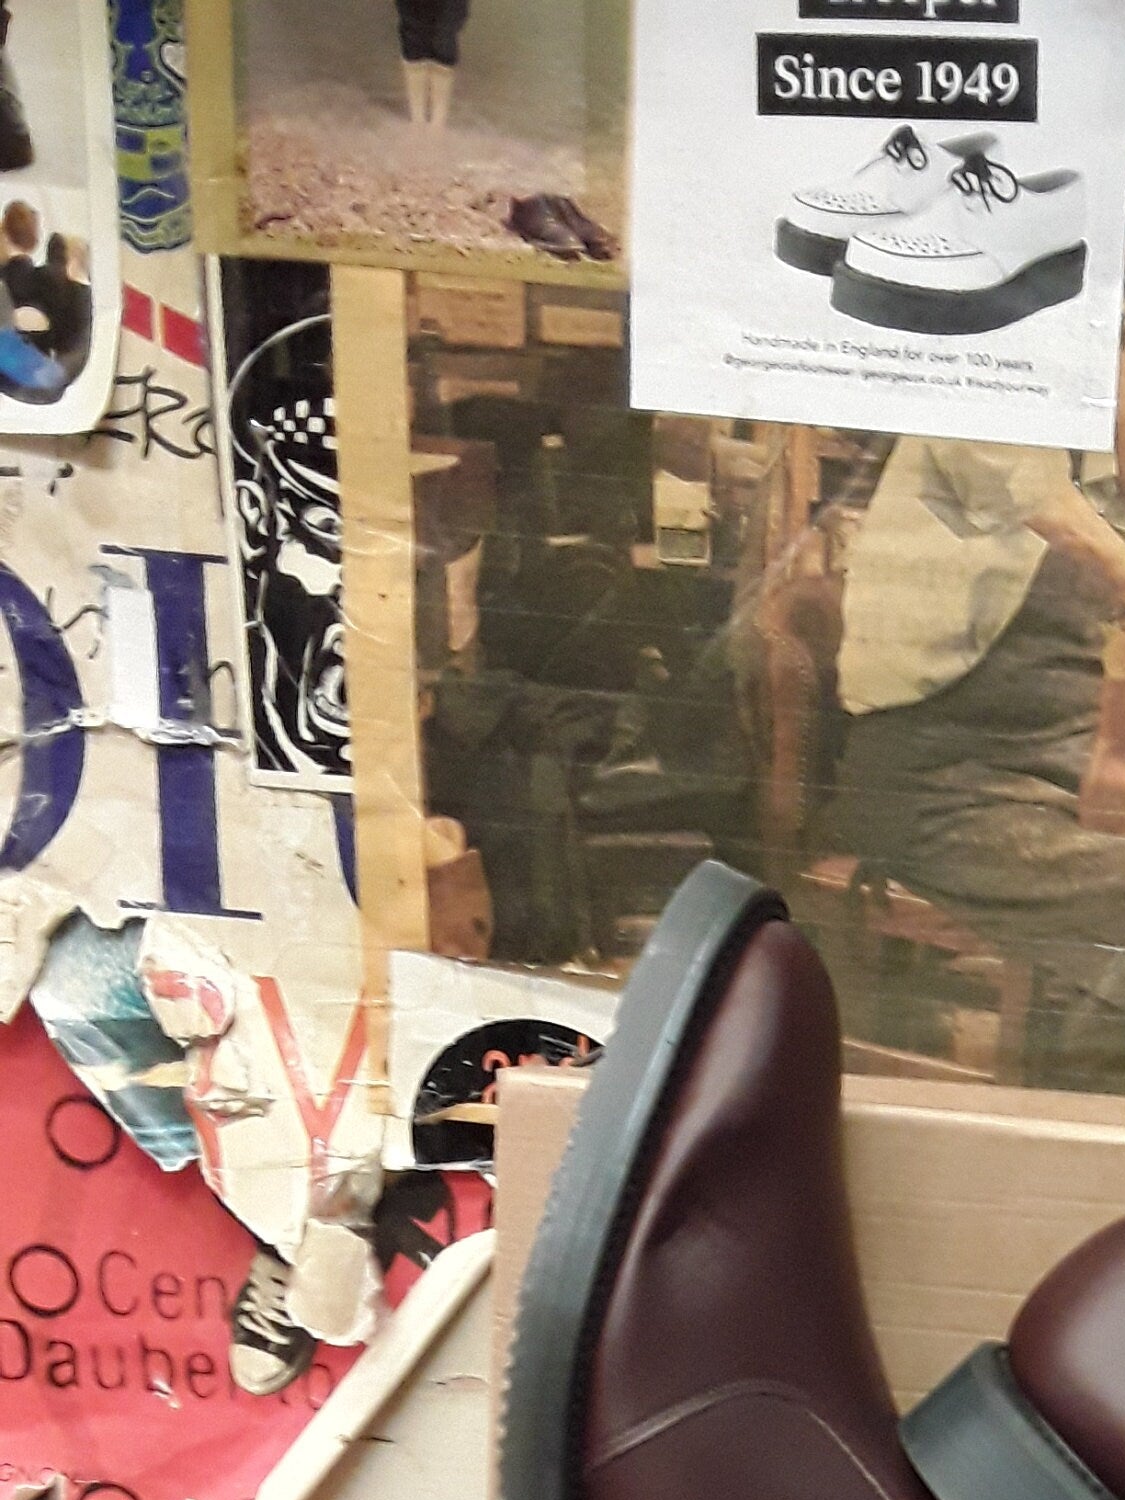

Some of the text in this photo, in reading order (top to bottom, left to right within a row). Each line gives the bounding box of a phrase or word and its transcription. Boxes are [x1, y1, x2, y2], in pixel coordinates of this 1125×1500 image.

[774, 53, 1019, 106] Since 1949
[841, 340, 900, 360] England
